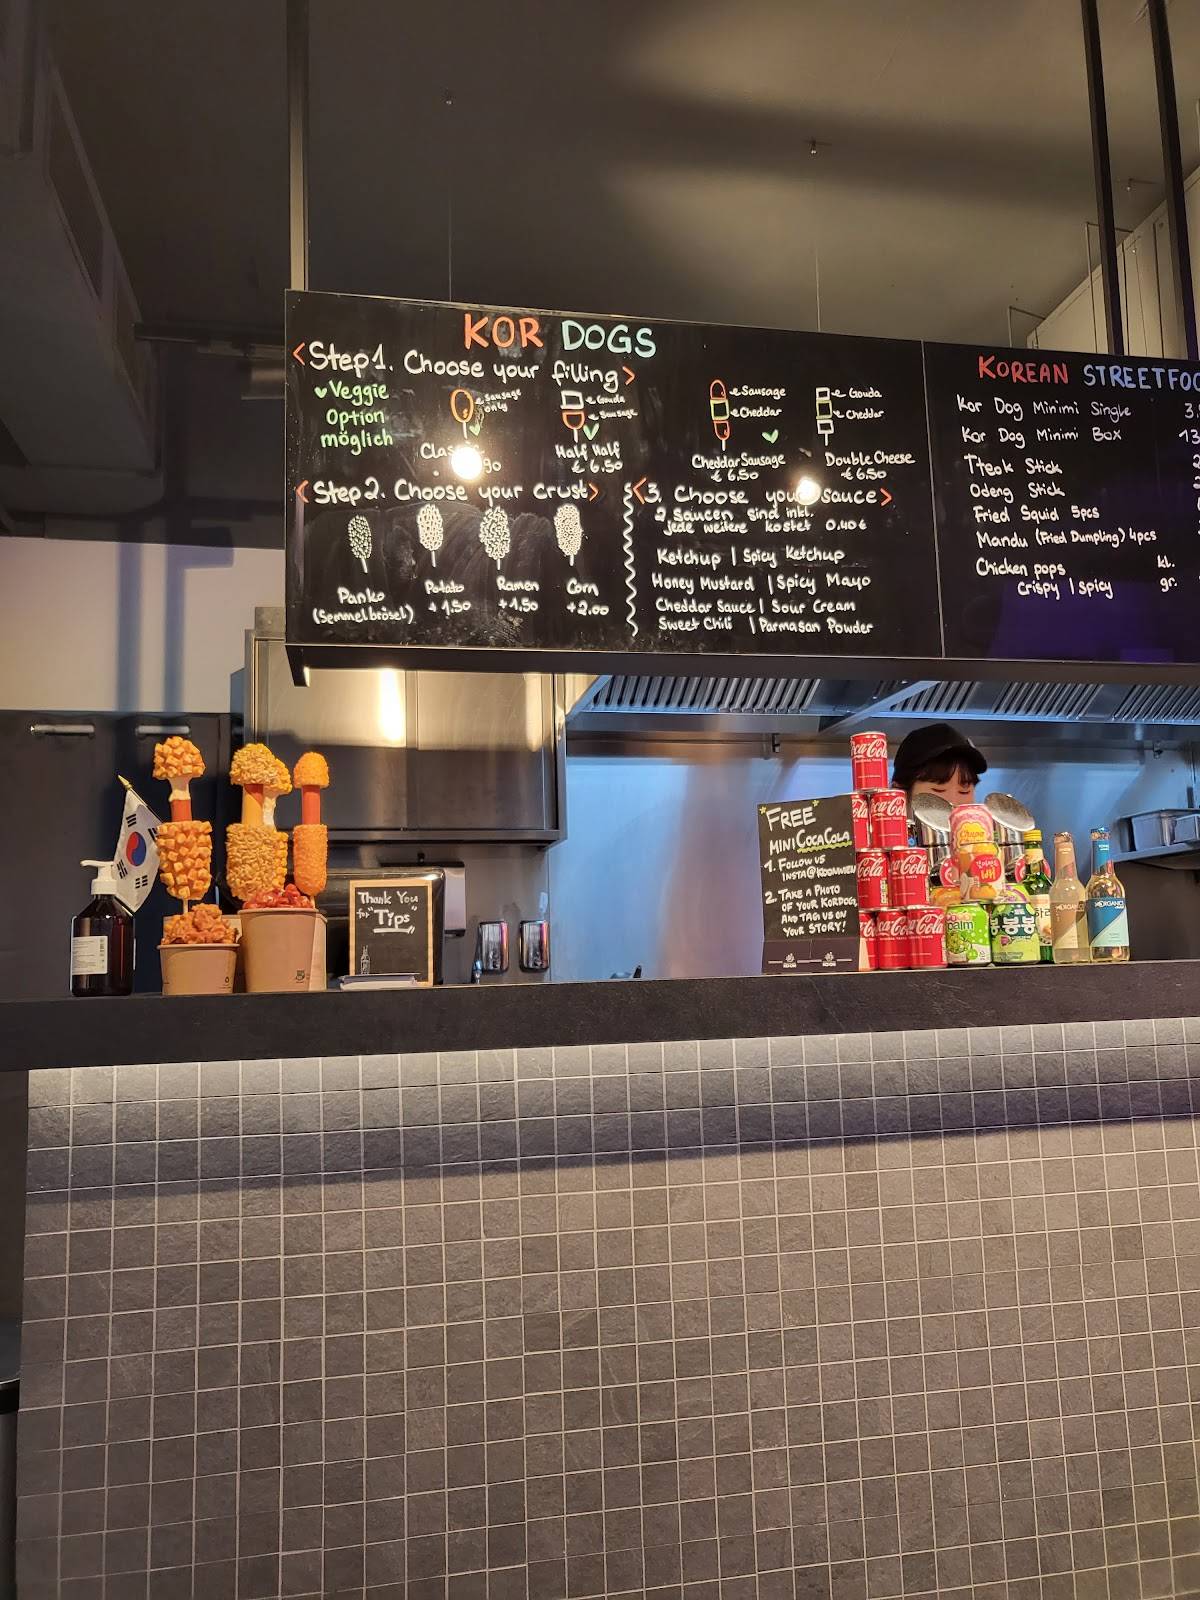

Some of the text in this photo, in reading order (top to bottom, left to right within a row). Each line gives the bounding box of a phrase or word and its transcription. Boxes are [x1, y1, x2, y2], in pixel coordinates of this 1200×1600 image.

[464, 313, 656, 358] KOR DOGS
[403, 350, 485, 378] Choose
[493, 361, 540, 384] your
[551, 360, 619, 392] filling
[978, 355, 1069, 384] KOREAN
[328, 380, 389, 406] Veggie
[741, 386, 787, 399] Sausage
[848, 387, 883, 399] Gouda
[739, 406, 782, 418] Cheddar
[845, 408, 885, 420] Cheddar
[956, 394, 983, 413] Kor
[994, 397, 1024, 421] Dog
[1033, 399, 1080, 416] Minimi
[1090, 401, 1132, 423] Single
[326, 408, 385, 432] Option
[320, 430, 394, 455] möglich
[961, 426, 987, 443] Kor
[998, 427, 1026, 449] Dog
[1036, 427, 1079, 441] Minimi
[1092, 427, 1122, 442] Box
[554, 441, 621, 461] Half Half
[691, 451, 786, 469] Cheddar Sausage
[825, 450, 916, 467] Double Cheese
[590, 457, 624, 474] 6.50
[856, 468, 887, 480] 6.50
[963, 452, 1014, 477] Tteok
[1025, 457, 1063, 475] Stick
[727, 469, 759, 481] 6.50
[394, 478, 468, 501] Choose
[478, 485, 524, 507] your
[673, 486, 749, 505] Choose
[969, 481, 1066, 504] Odeng Stick
[972, 504, 1100, 524] Fried Squid 5pcs
[663, 520, 695, 536] jede
[703, 521, 748, 534] weitere
[765, 519, 812, 533] kostet
[976, 527, 1158, 549] Mandu (Fried Dumpling) 4pcs
[656, 545, 845, 570] Ketchup Spicy Ketchup
[975, 556, 1029, 577] Chicken
[1034, 562, 1067, 580] pops
[424, 579, 465, 595] Potato
[496, 575, 540, 591] Ramen
[566, 577, 599, 597] Corn
[651, 572, 871, 594] Honey Mustard Spicy Mayo
[337, 586, 386, 604] Panko
[655, 597, 856, 614] Cheddar Sauce Sour Cream
[658, 615, 874, 634] Sweet Chili Parmasan Powder
[765, 805, 817, 832] FREE
[769, 839, 796, 856] MINI
[357, 890, 419, 904] Thank You
[778, 888, 803, 902] TAKE
[805, 888, 812, 897] A
[814, 884, 841, 897] PHOTO
[781, 901, 793, 912] OF
[796, 899, 819, 912] YOUR
[799, 911, 820, 922] TAG
[783, 926, 805, 938] YOUR
[809, 920, 847, 934] STORY!
